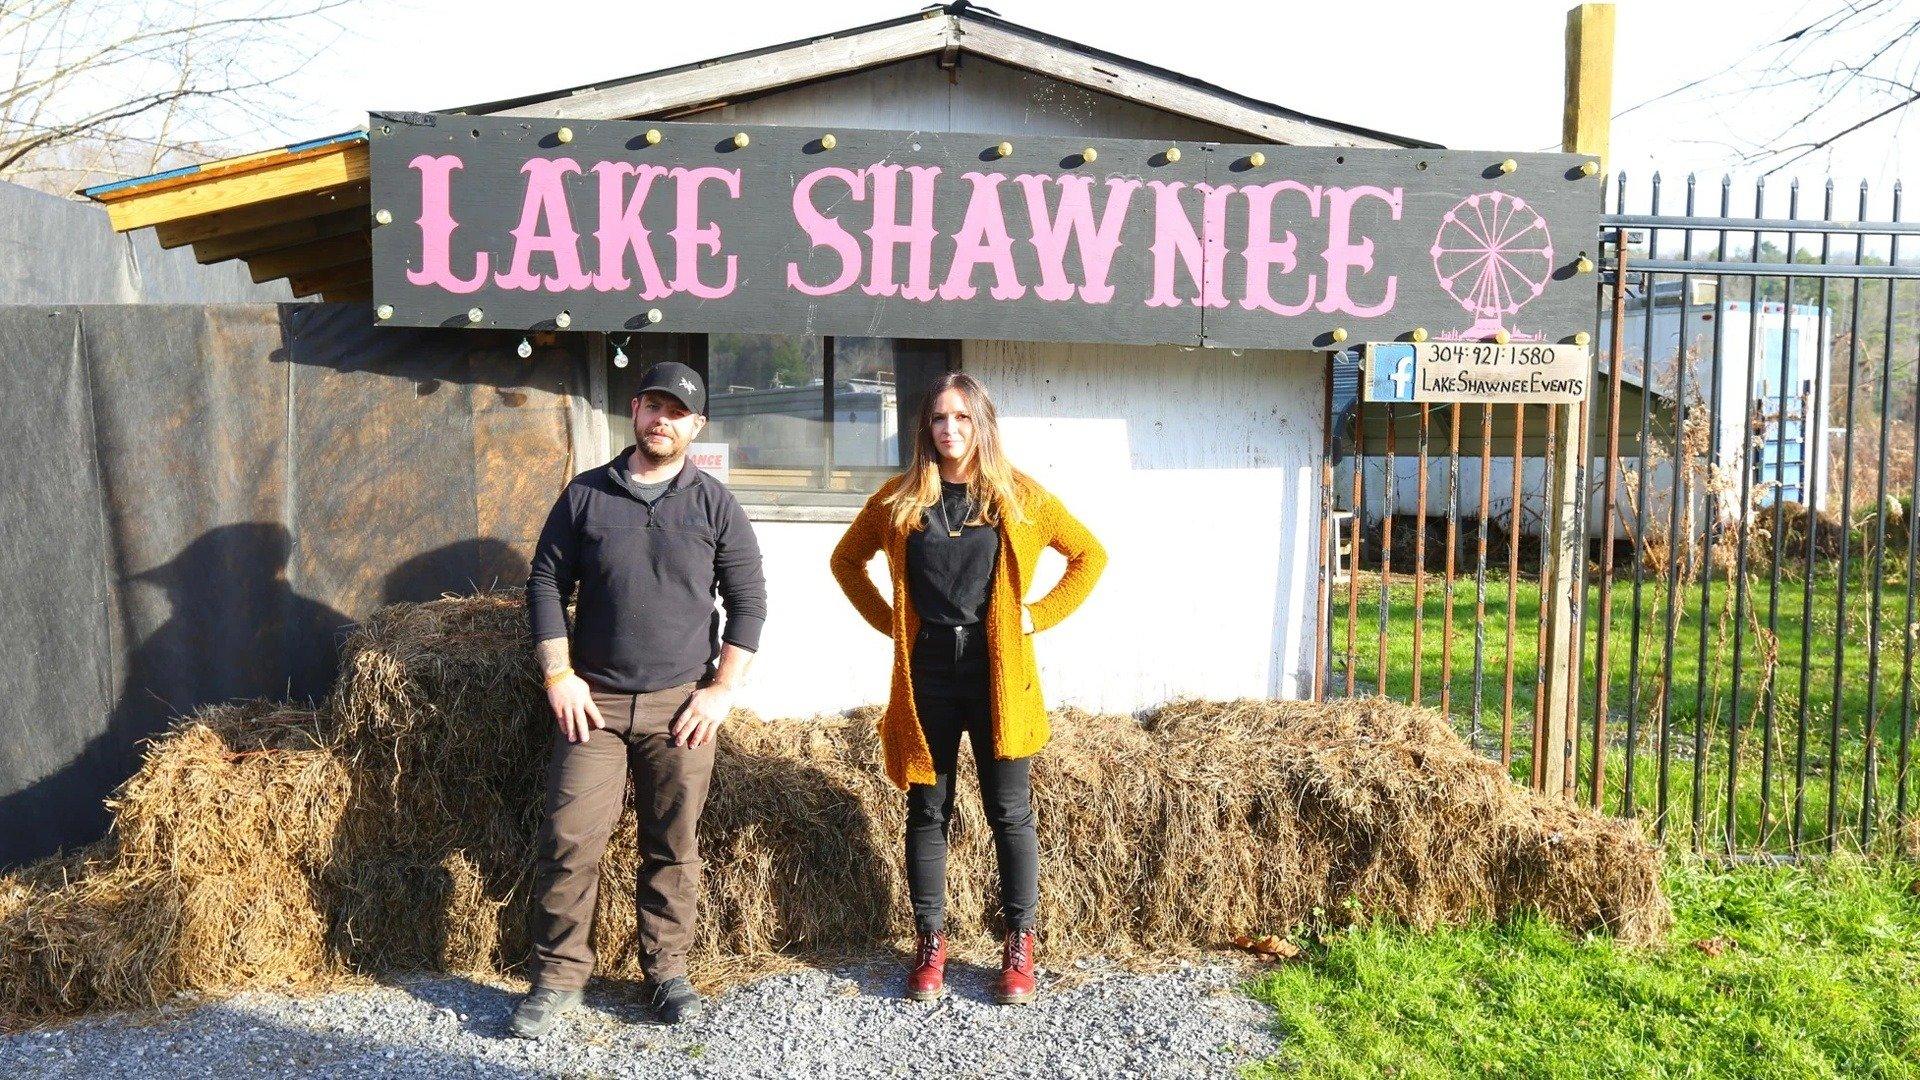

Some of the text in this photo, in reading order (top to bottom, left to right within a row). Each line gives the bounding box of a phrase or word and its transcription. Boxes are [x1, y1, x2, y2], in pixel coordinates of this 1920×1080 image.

[407, 154, 1404, 317] LAKE SHAWNEE
[1388, 356, 1413, 399] f
